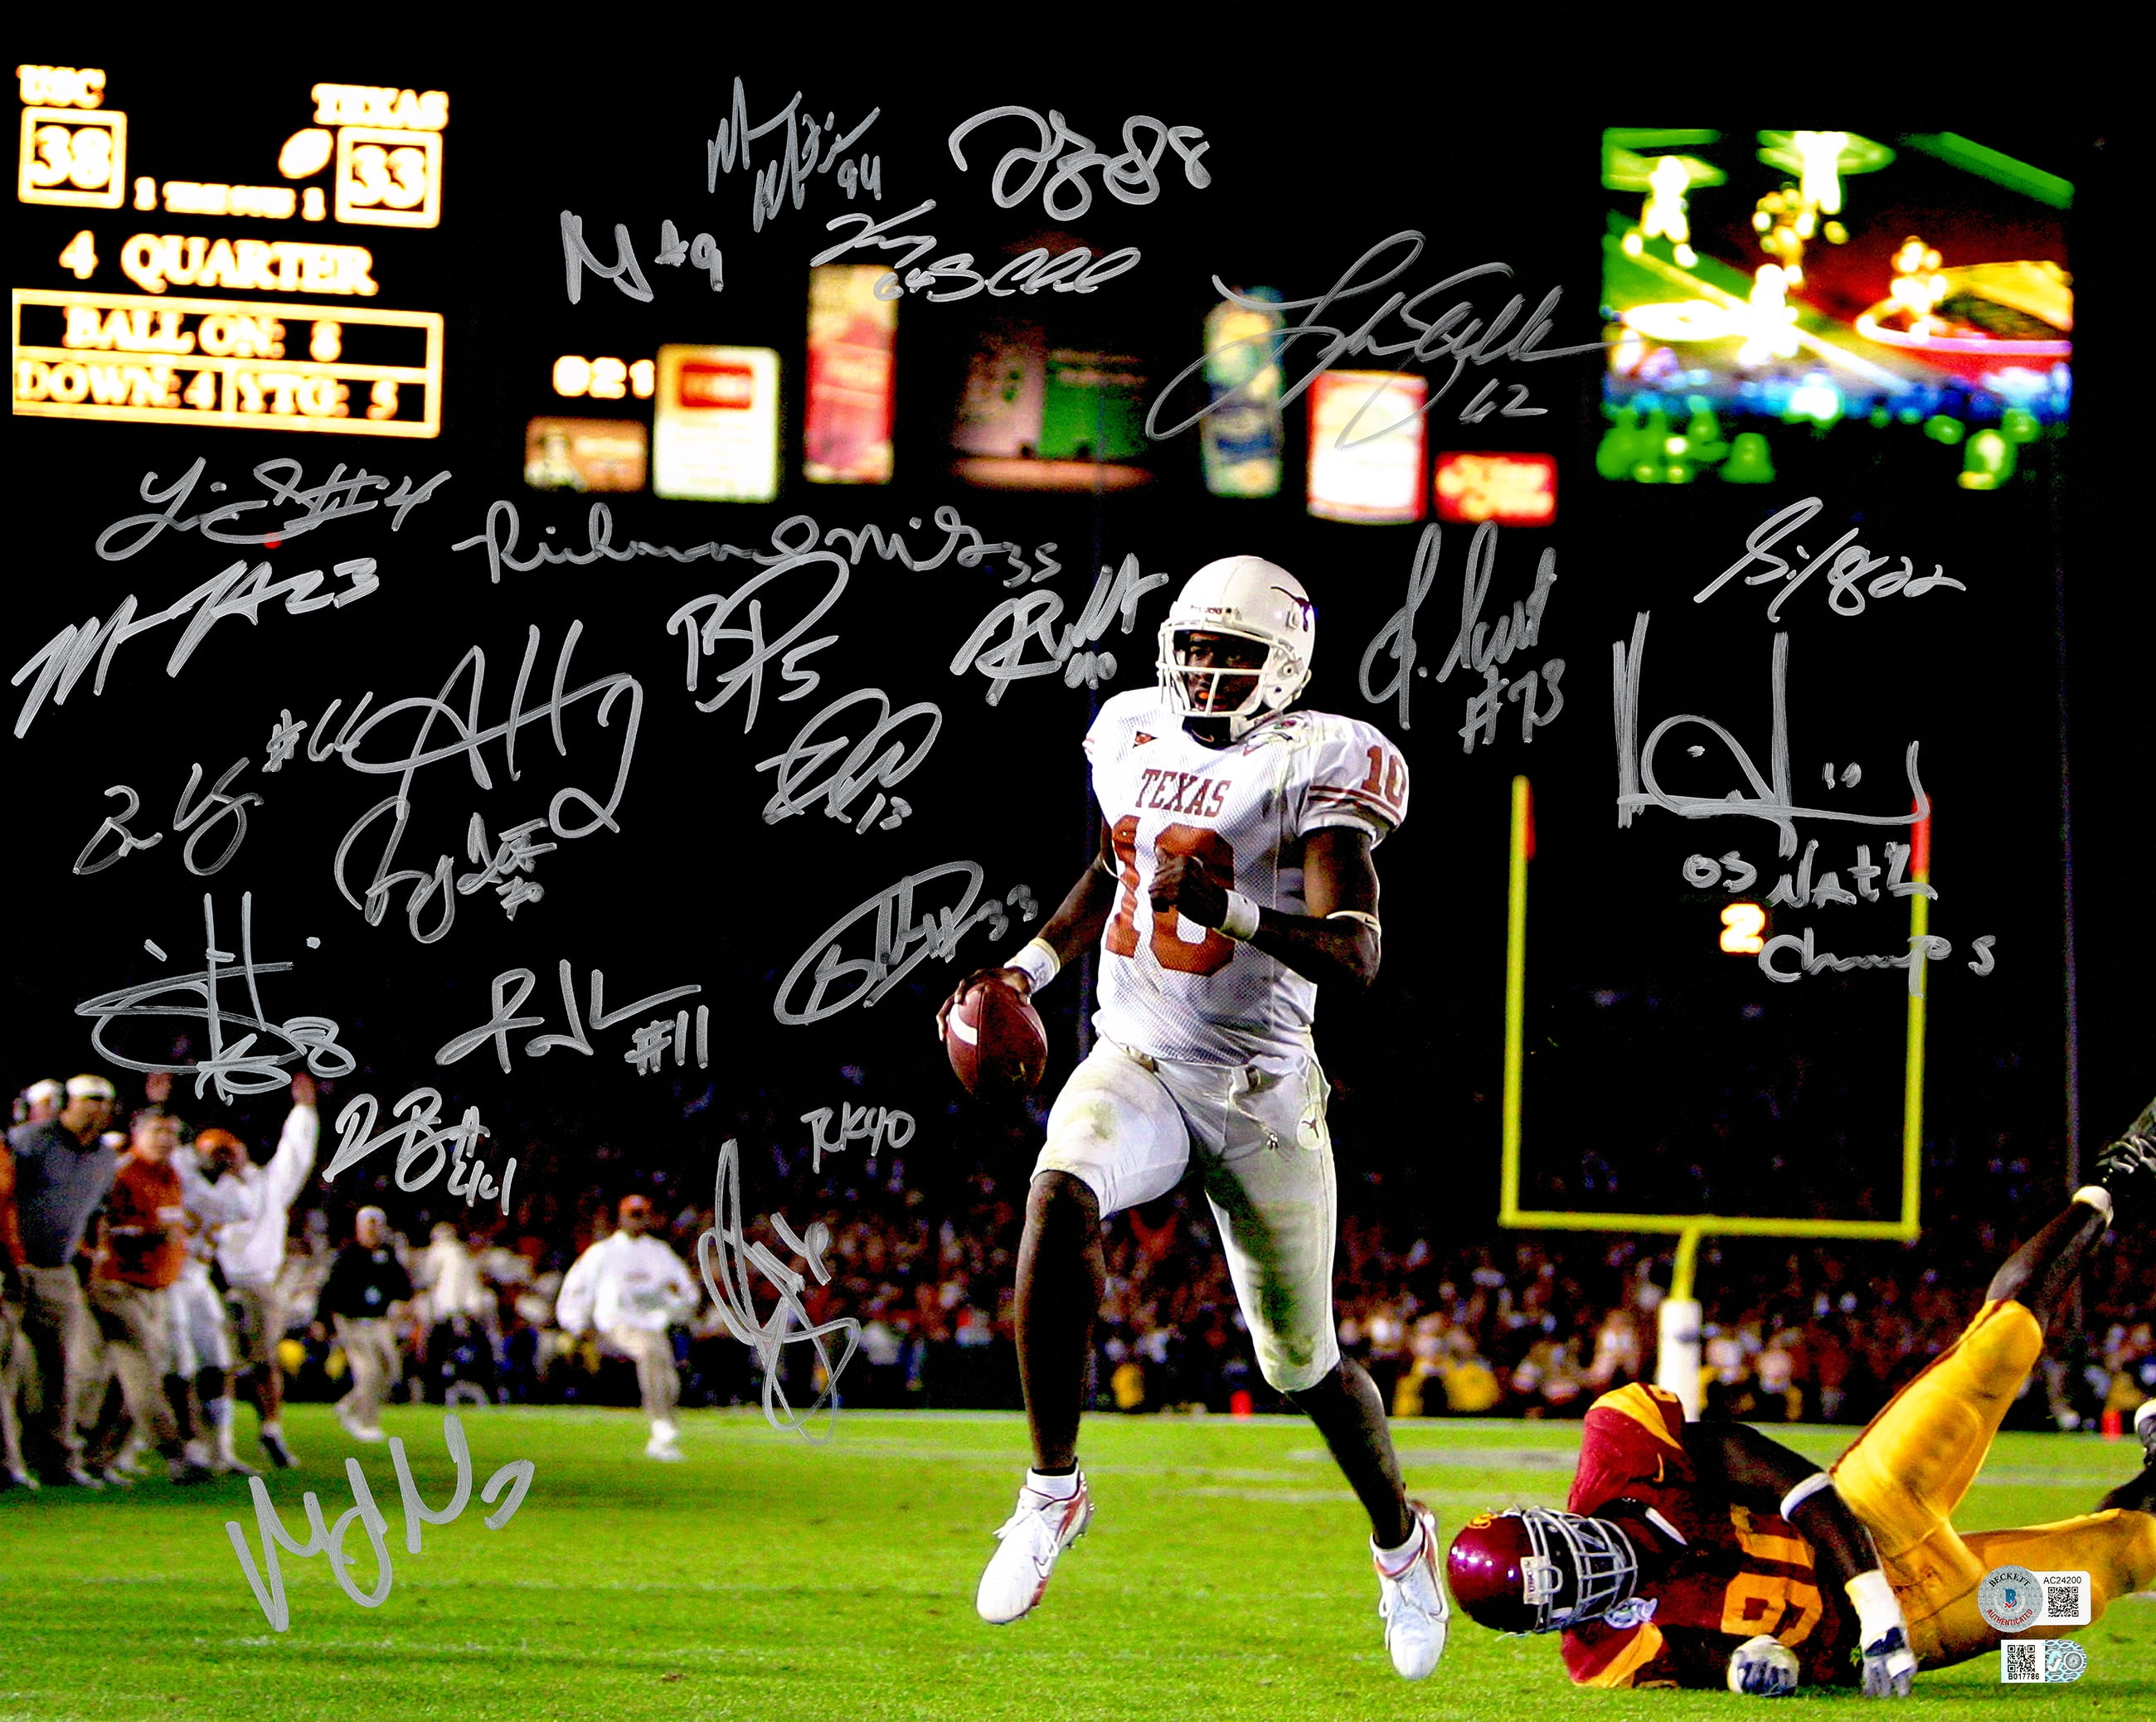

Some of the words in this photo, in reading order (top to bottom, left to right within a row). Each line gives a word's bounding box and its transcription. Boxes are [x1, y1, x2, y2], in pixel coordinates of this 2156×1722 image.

[30, 124, 112, 189] 38
[349, 144, 426, 209] 33
[59, 230, 99, 279] 4
[120, 233, 379, 296] QUARTER
[63, 304, 196, 355] BALL
[1136, 769, 1231, 817] TEXAS
[1362, 746, 1407, 810] 10
[1105, 815, 1236, 977] 10
[1720, 903, 1765, 954] 2
[1988, 1573, 2031, 1588] BECKETT
[2043, 1576, 2081, 1584] AC24200
[1986, 1608, 2033, 1626] AUTHENTICATED
[2008, 1672, 2040, 1681] B017786
